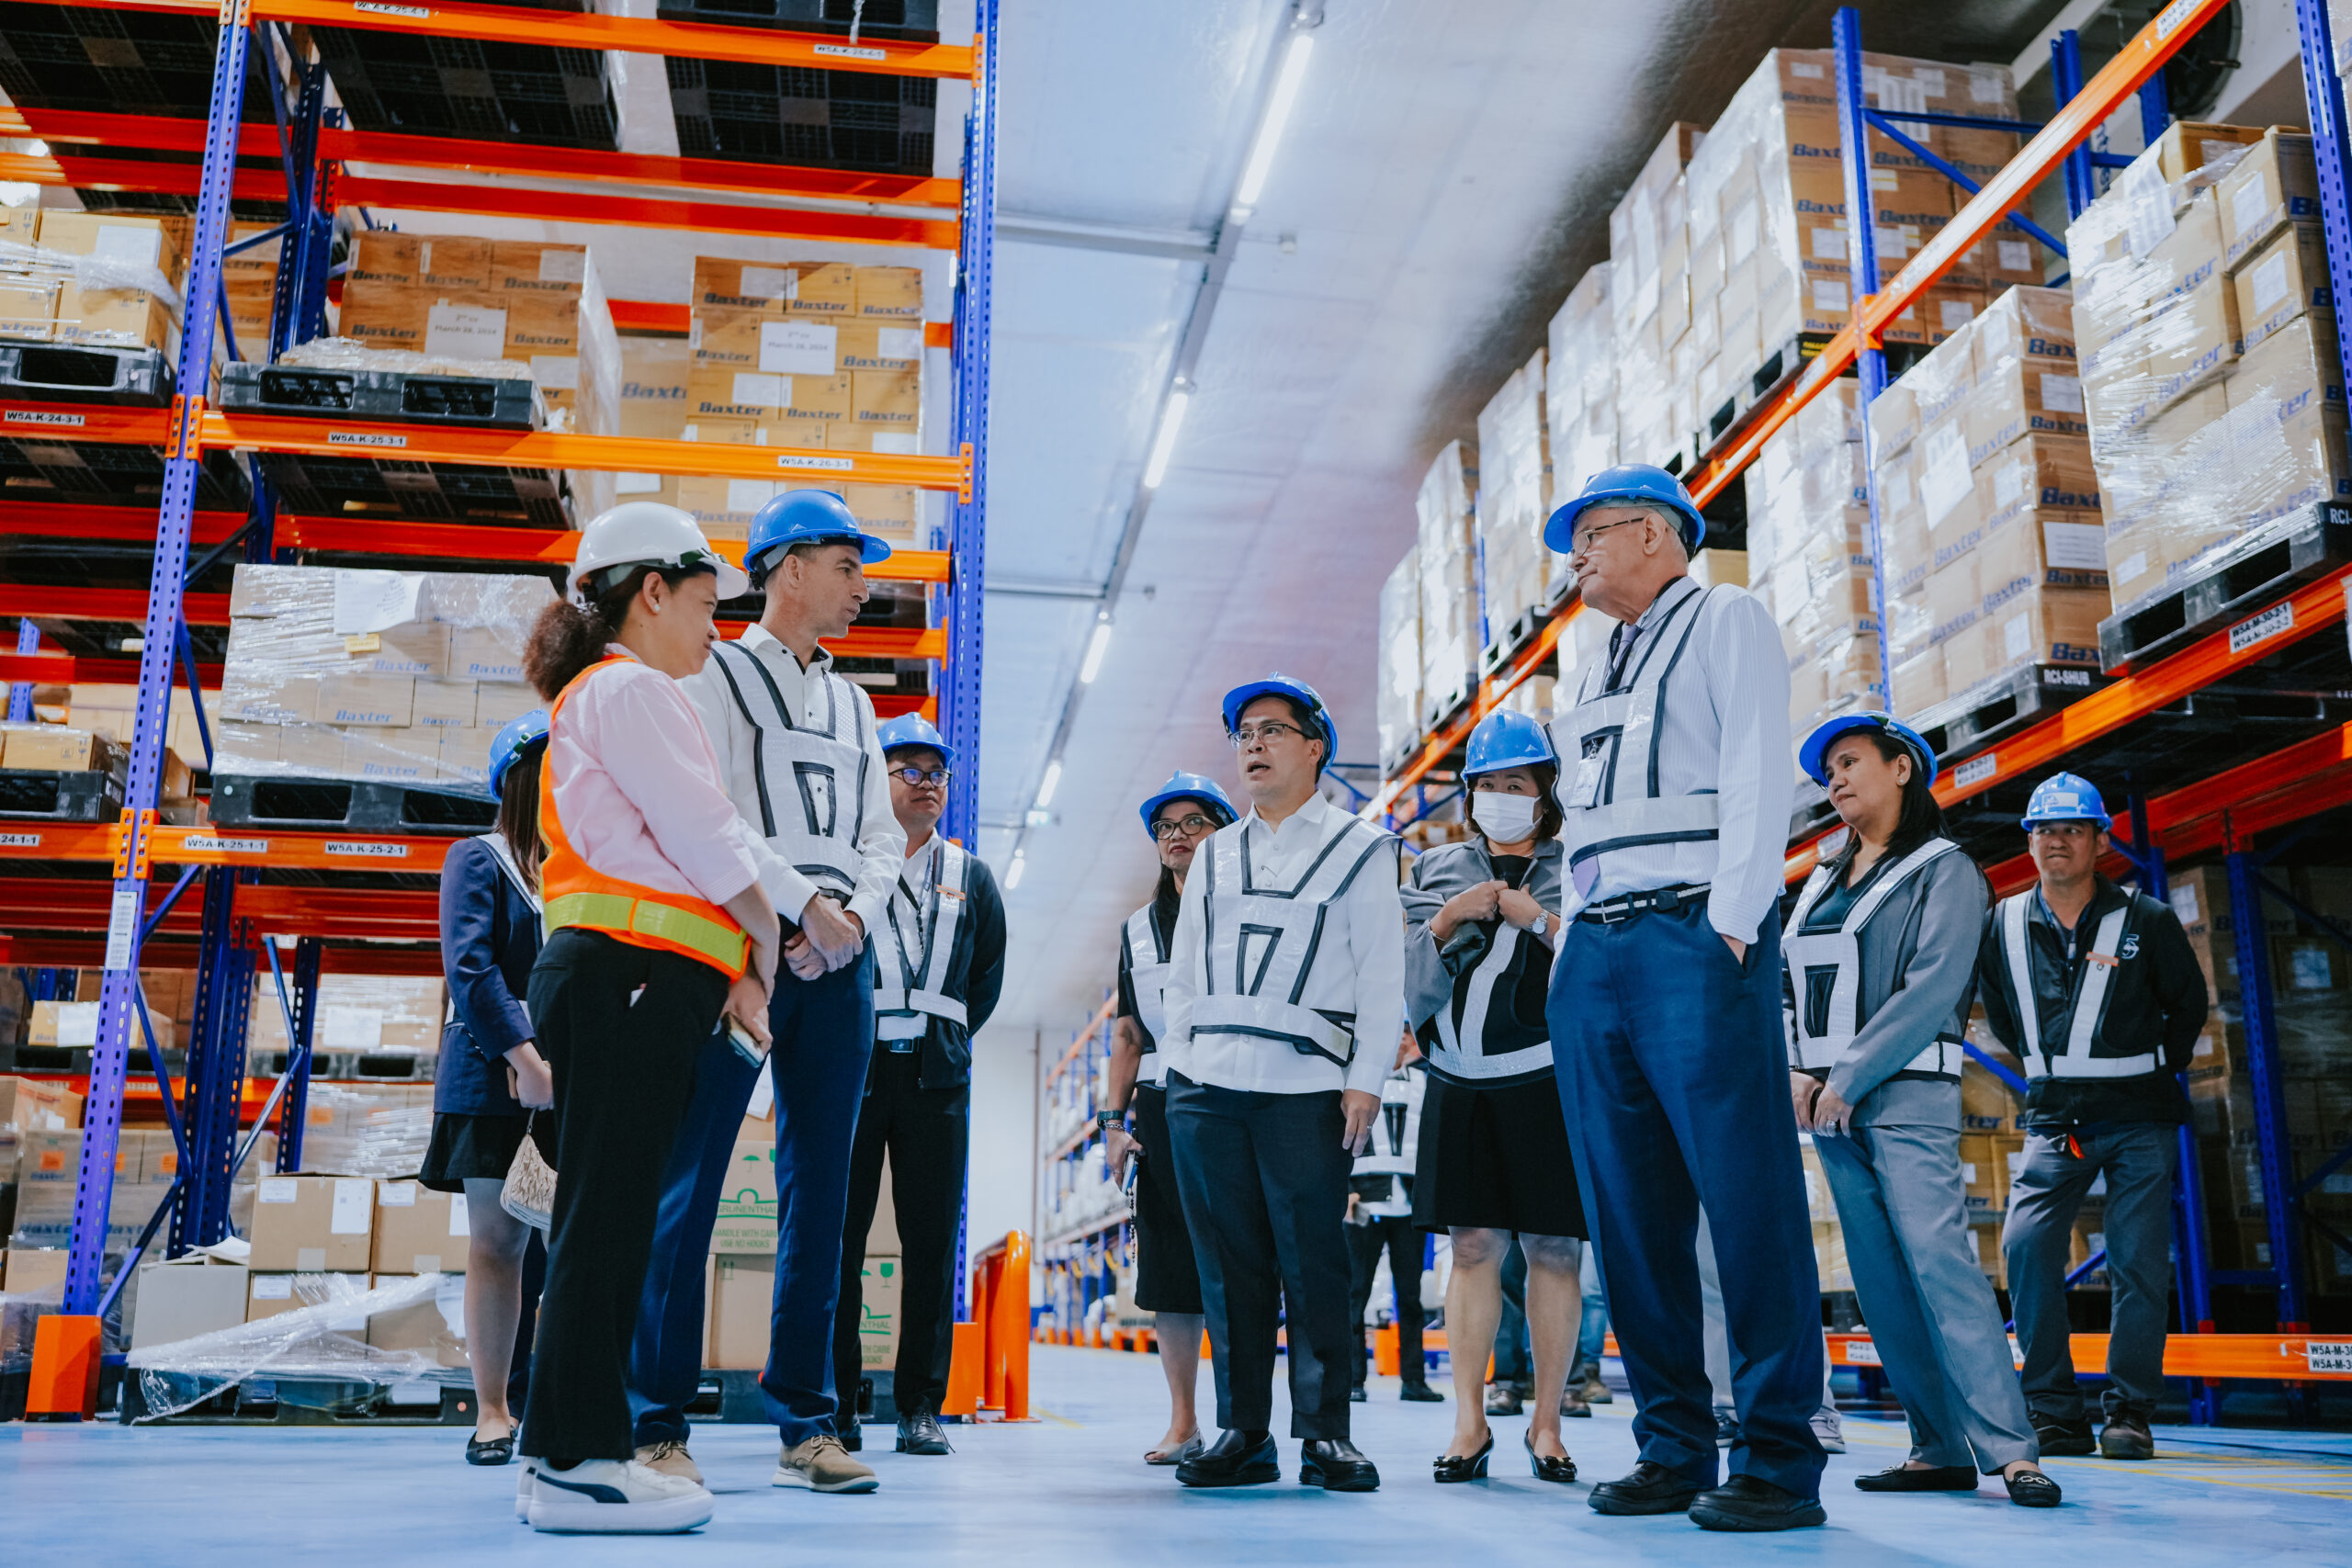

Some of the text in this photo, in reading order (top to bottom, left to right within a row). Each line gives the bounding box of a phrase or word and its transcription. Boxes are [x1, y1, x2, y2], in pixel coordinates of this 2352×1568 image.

[1792, 143, 1841, 158] Baxt
[1797, 199, 1846, 215] Baxt
[352, 269, 410, 283] Baxter
[425, 273, 481, 287] Baxter
[504, 276, 570, 291] Baxter
[705, 292, 769, 308] Baxter
[793, 299, 848, 311] Baxter
[864, 305, 920, 316] Baxter
[352, 324, 419, 339] Baxter
[1805, 319, 1847, 331] Baxt
[514, 333, 571, 346] Baxter
[2029, 338, 2075, 358] Bax
[696, 349, 752, 361] Baxter
[843, 355, 909, 369] Baxter
[621, 382, 686, 400] Baxt
[699, 401, 766, 416] Baxter
[786, 408, 843, 420] Baxter
[858, 411, 914, 421] Baxter
[2030, 415, 2088, 432] Baxte
[2041, 487, 2101, 507] Baxt
[2051, 642, 2098, 661] Bax
[374, 660, 432, 672] Baxter
[335, 710, 393, 723] Baxter
[422, 716, 463, 727] Baxter
[363, 763, 420, 776] Baxter
[187, 839, 265, 850] W5A-K-25-1-1
[327, 842, 404, 854] W5A-K-25-2-1
[741, 1229, 760, 1237] WITH
[747, 1240, 770, 1249] HOOKS
[873, 1345, 891, 1354] CARE
[2312, 1359, 2352, 1370] W5A-M-3
